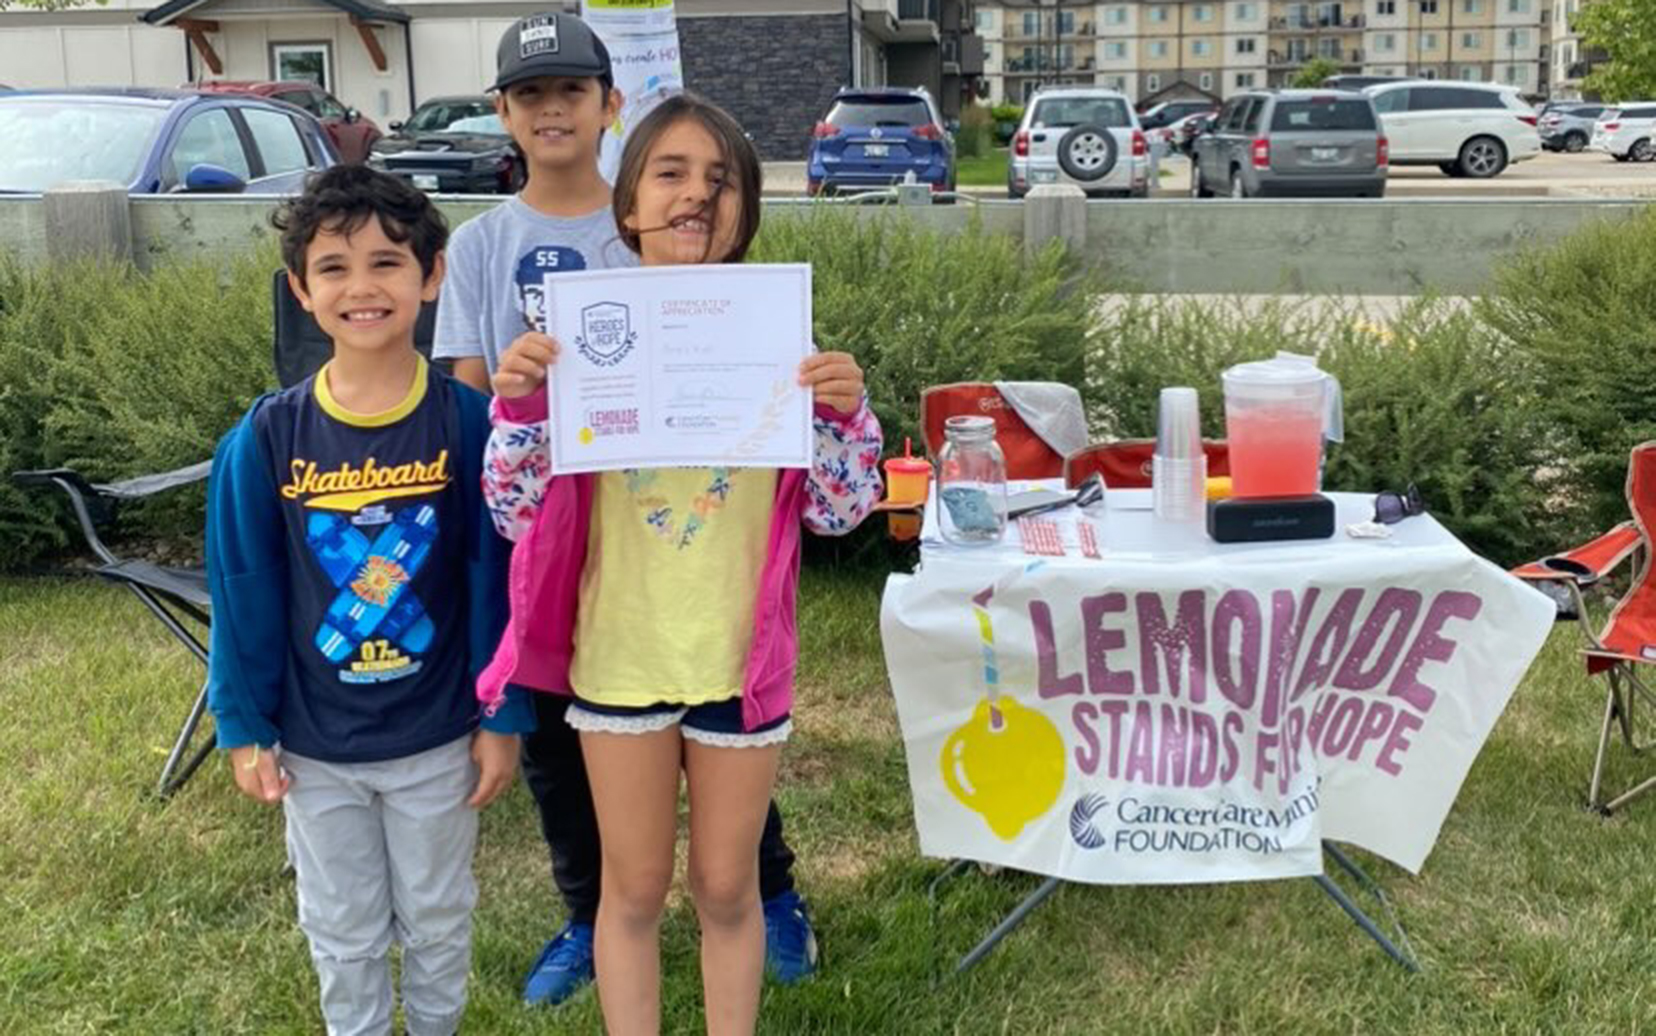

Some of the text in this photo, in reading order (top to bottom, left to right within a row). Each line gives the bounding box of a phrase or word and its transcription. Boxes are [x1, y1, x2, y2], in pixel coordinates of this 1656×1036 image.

[588, 319, 624, 333] HEROES
[590, 408, 639, 427] LEMONADE
[282, 449, 452, 499] Skateboard
[1028, 586, 1483, 728] LEMONADE
[1071, 700, 1244, 788] STANDS
[1306, 692, 1424, 777] HOPE
[1114, 827, 1283, 854] FOUNDATION
